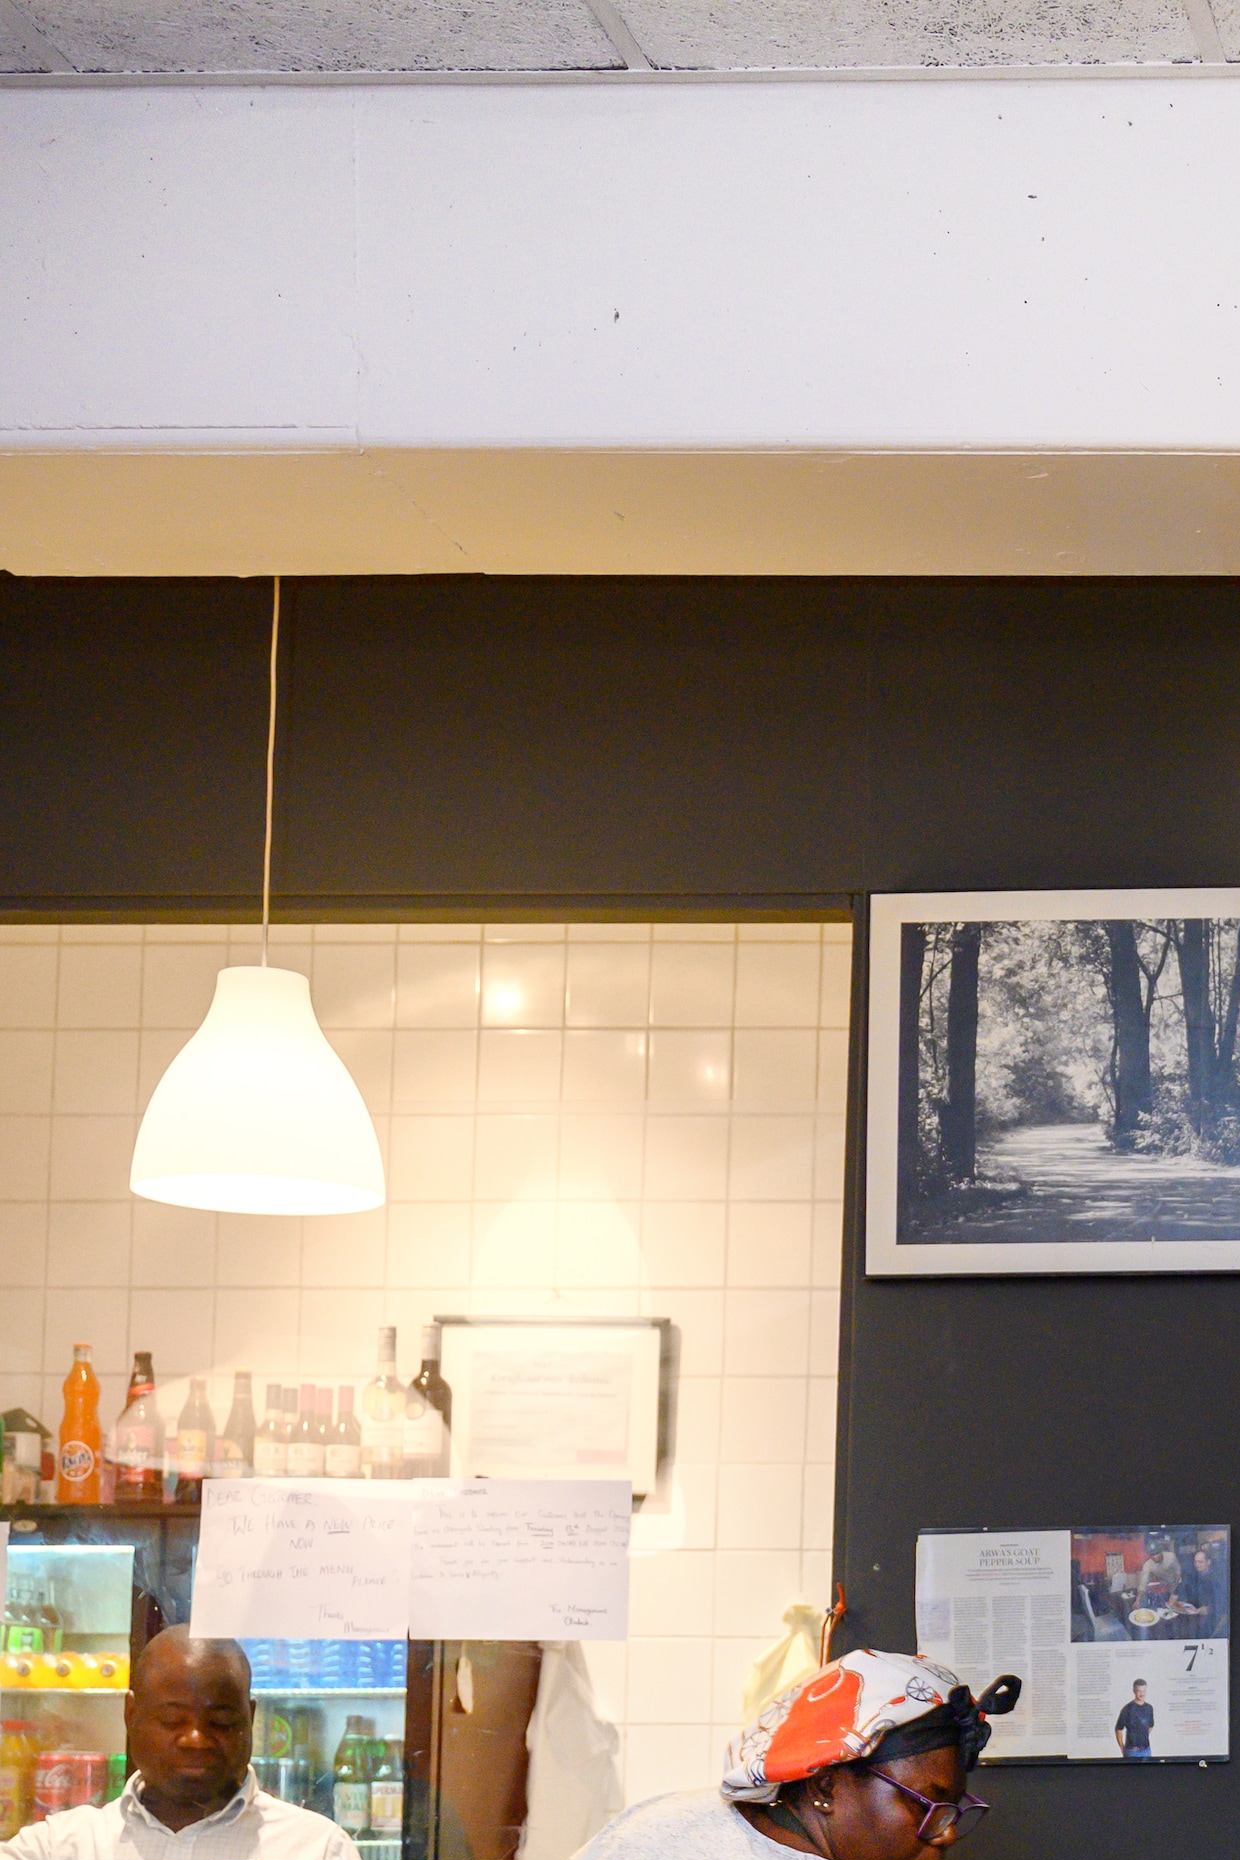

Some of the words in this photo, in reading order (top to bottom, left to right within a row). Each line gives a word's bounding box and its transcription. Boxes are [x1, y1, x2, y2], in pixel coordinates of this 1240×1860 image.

[304, 1519, 316, 1532] A
[323, 1518, 352, 1534] NEW
[289, 1537, 315, 1550] NOW
[1013, 1548, 1040, 1557] GOAT
[979, 1557, 1014, 1567] PEPPER
[1015, 1556, 1040, 1566] SOUP
[288, 1567, 309, 1580] THE
